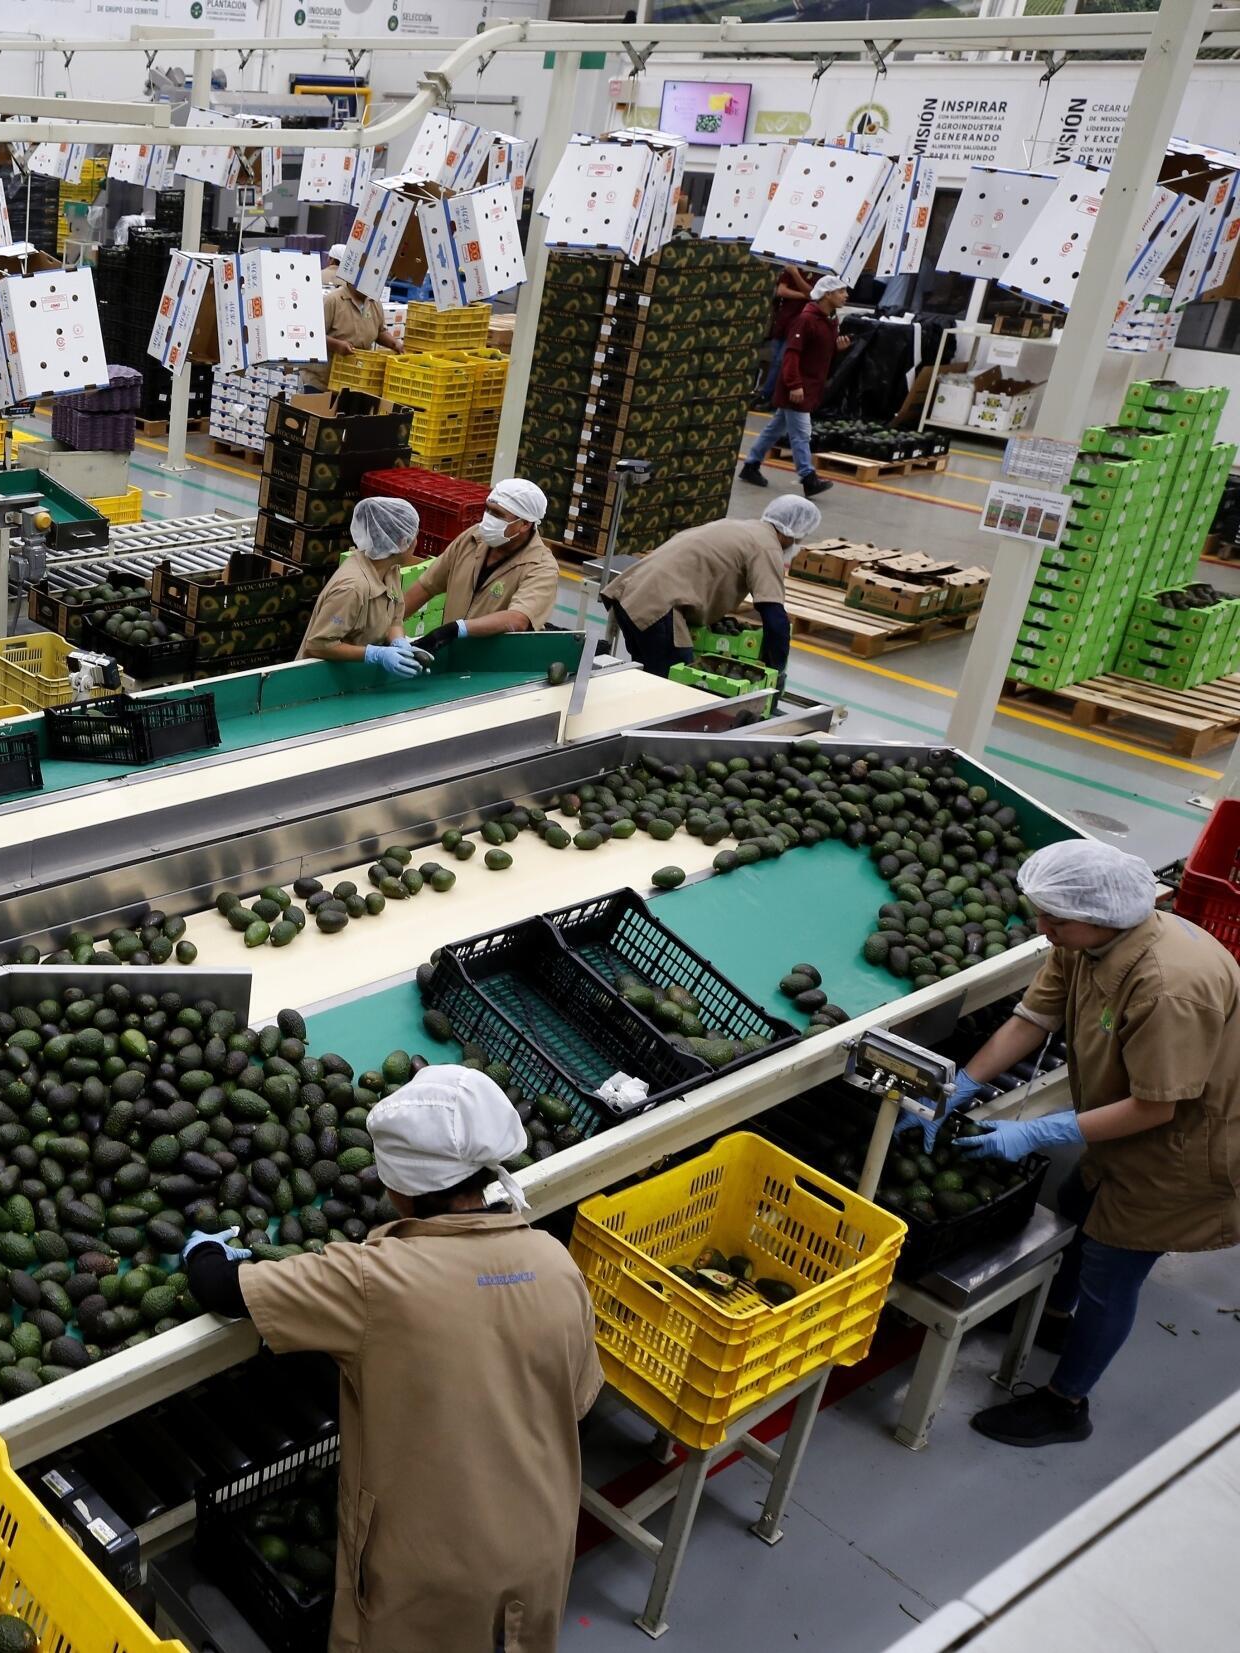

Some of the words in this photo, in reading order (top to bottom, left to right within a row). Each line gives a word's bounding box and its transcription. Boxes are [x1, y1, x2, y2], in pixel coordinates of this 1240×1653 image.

[941, 100, 1008, 113] INSPIRAR
[1092, 104, 1121, 112] CREAR
[912, 98, 938, 156] MISIÓN
[936, 122, 1002, 131] AGROINDUSTRIA
[1053, 98, 1088, 165] VISIÓN
[933, 132, 1000, 142] GENERANDO
[1078, 154, 1094, 164] DE
[236, 581, 279, 592] AVOCADOS
[232, 617, 274, 628] AVOCADOS
